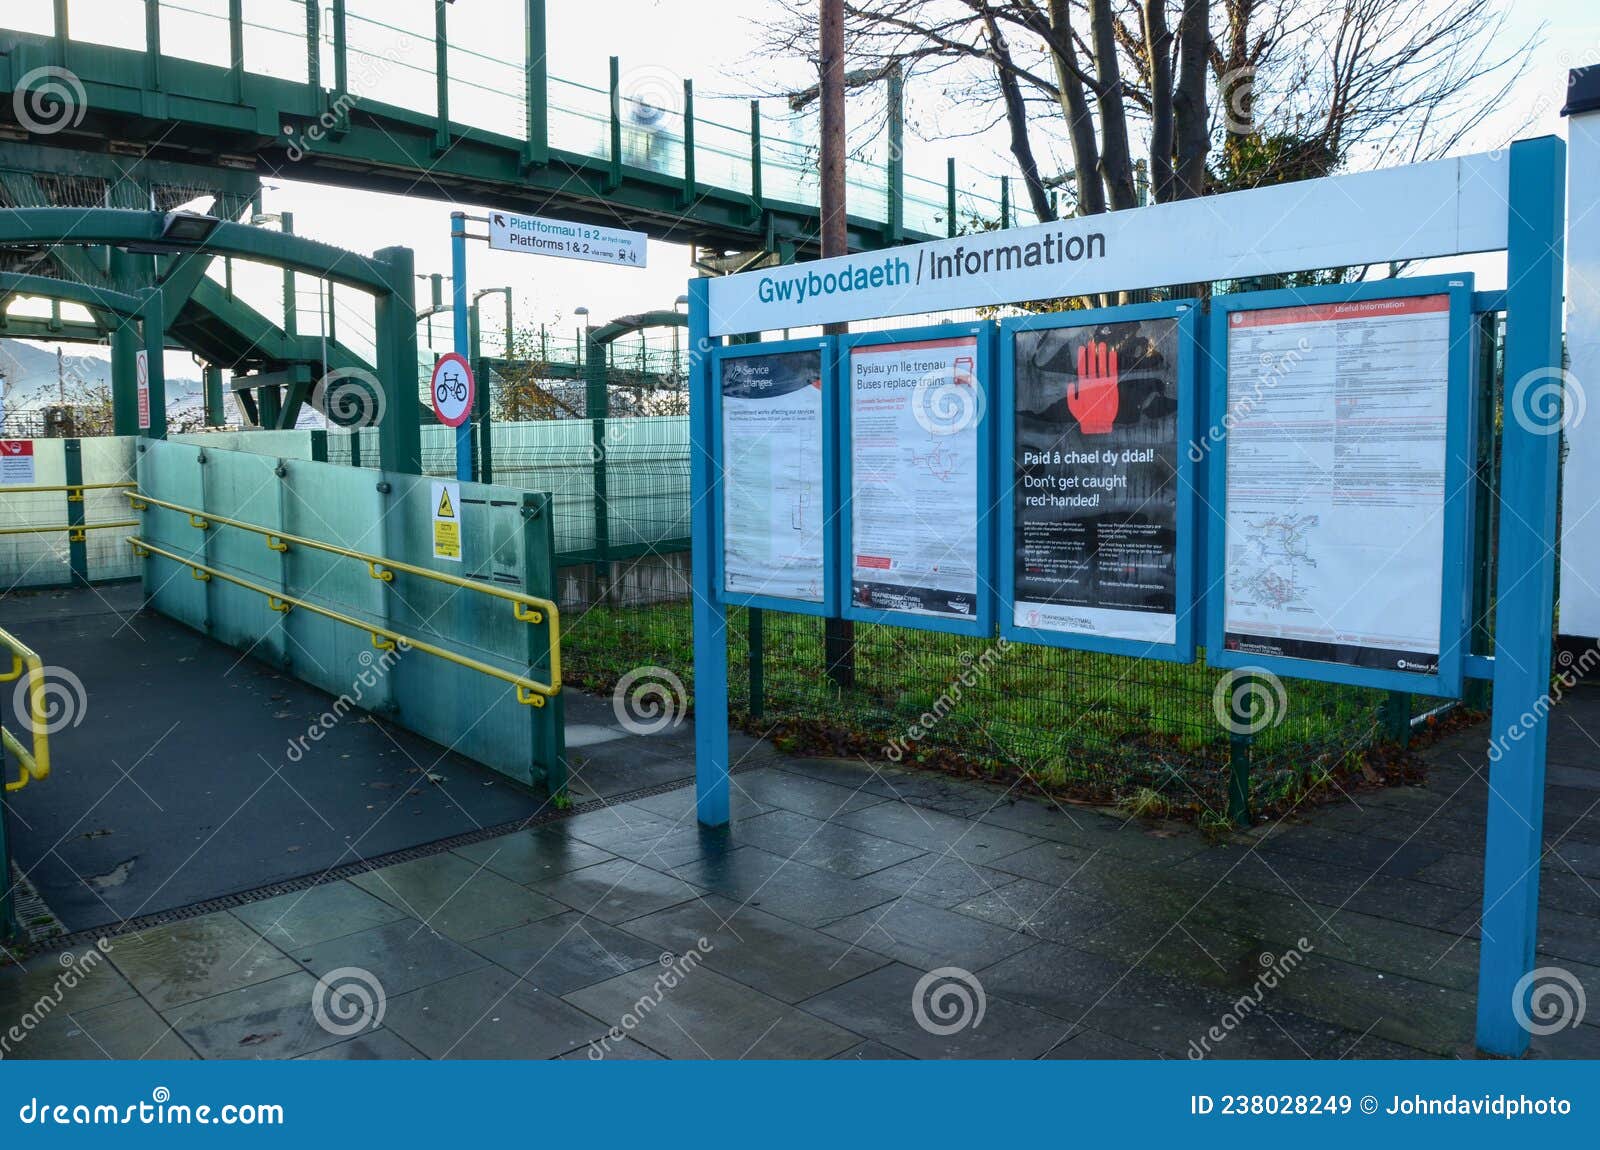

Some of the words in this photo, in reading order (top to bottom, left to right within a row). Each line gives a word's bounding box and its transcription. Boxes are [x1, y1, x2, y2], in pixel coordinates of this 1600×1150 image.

[510, 217, 575, 237] Platfformau
[578, 228, 582, 238] 1
[584, 231, 590, 239] a
[593, 230, 600, 240] 2
[510, 233, 564, 251] Platforms
[566, 241, 570, 251] 1
[572, 242, 580, 253] &
[583, 243, 590, 254] 2
[759, 257, 910, 304] Gwybodaeth
[931, 232, 1106, 280] Information
[1335, 303, 1359, 313] Useful
[1360, 301, 1405, 311] Information
[742, 365, 769, 376] Service
[856, 363, 884, 376] Bysiau
[887, 365, 898, 376] yn
[900, 360, 912, 372] lle
[914, 360, 946, 371] trenau
[743, 378, 773, 389] changes
[856, 379, 881, 390] Buses
[883, 378, 917, 392] replace
[919, 376, 945, 388] trains
[1024, 452, 1050, 465] Paid
[1053, 451, 1061, 464] â
[1064, 450, 1099, 464] chael
[1102, 450, 1118, 466] dy
[1121, 449, 1154, 463] ddal!
[1024, 474, 1056, 488] Don't
[1058, 477, 1079, 491] get
[1082, 474, 1127, 491] caught
[1026, 493, 1100, 507] red-handed!
